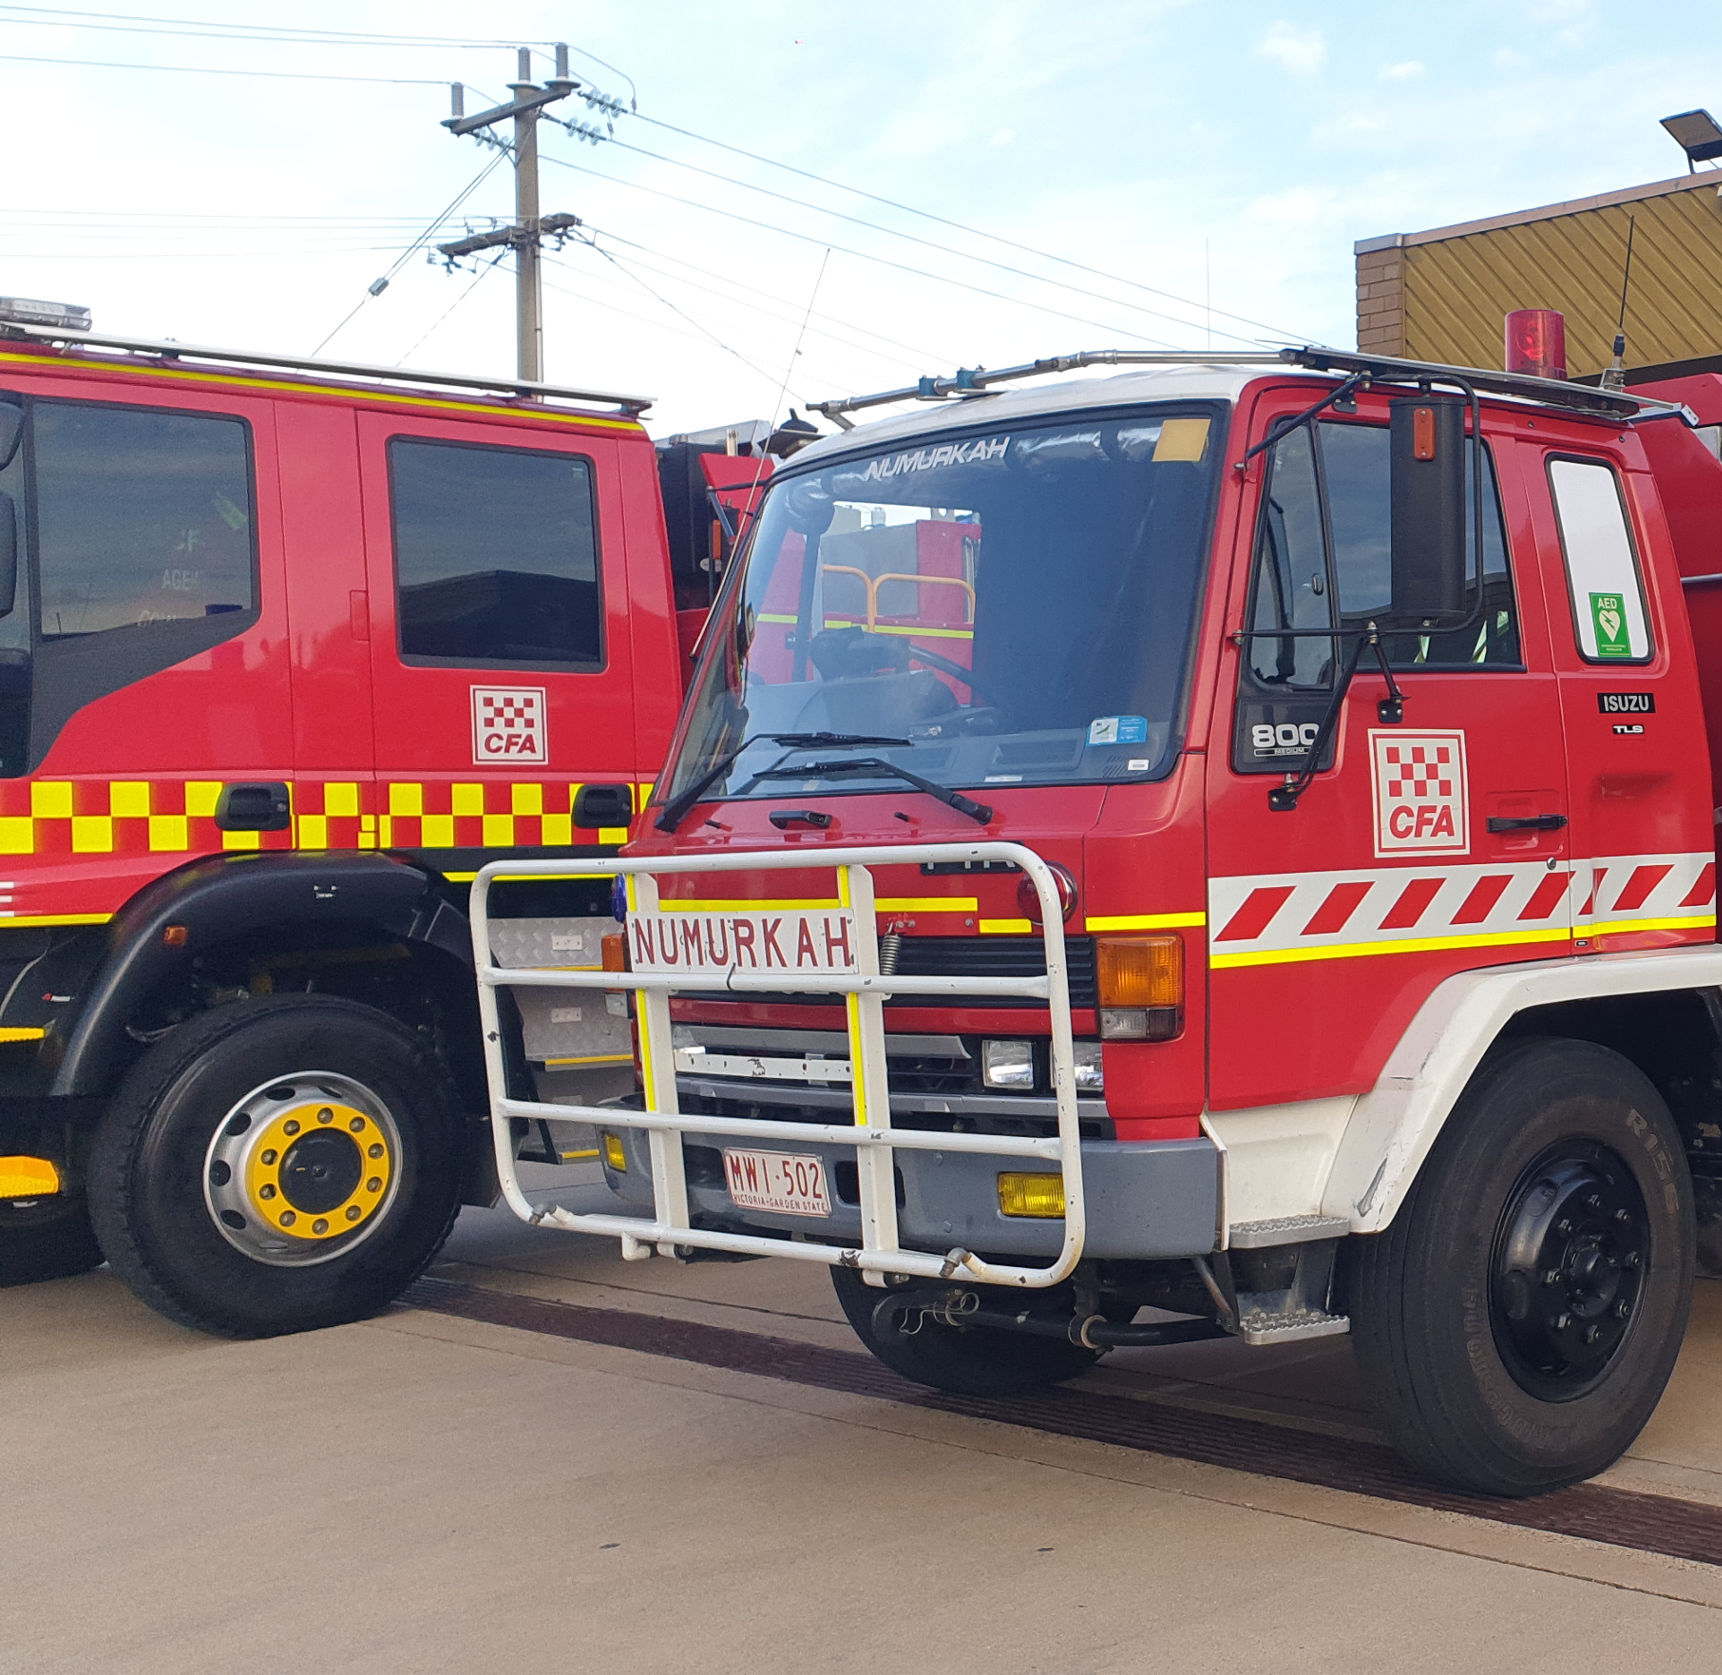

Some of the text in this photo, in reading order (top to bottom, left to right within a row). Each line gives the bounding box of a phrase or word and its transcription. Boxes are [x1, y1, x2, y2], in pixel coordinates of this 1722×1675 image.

[864, 436, 1011, 481] NUMURKAH
[1597, 597, 1617, 609] AED
[1603, 695, 1650, 712] ISUZU
[1251, 722, 1320, 748] 800
[1613, 725, 1644, 734] TLS
[484, 732, 537, 754] CFA
[1389, 804, 1456, 839] CFA
[634, 916, 852, 969] NUMURKAH
[803, 1201, 828, 1213] STATE
